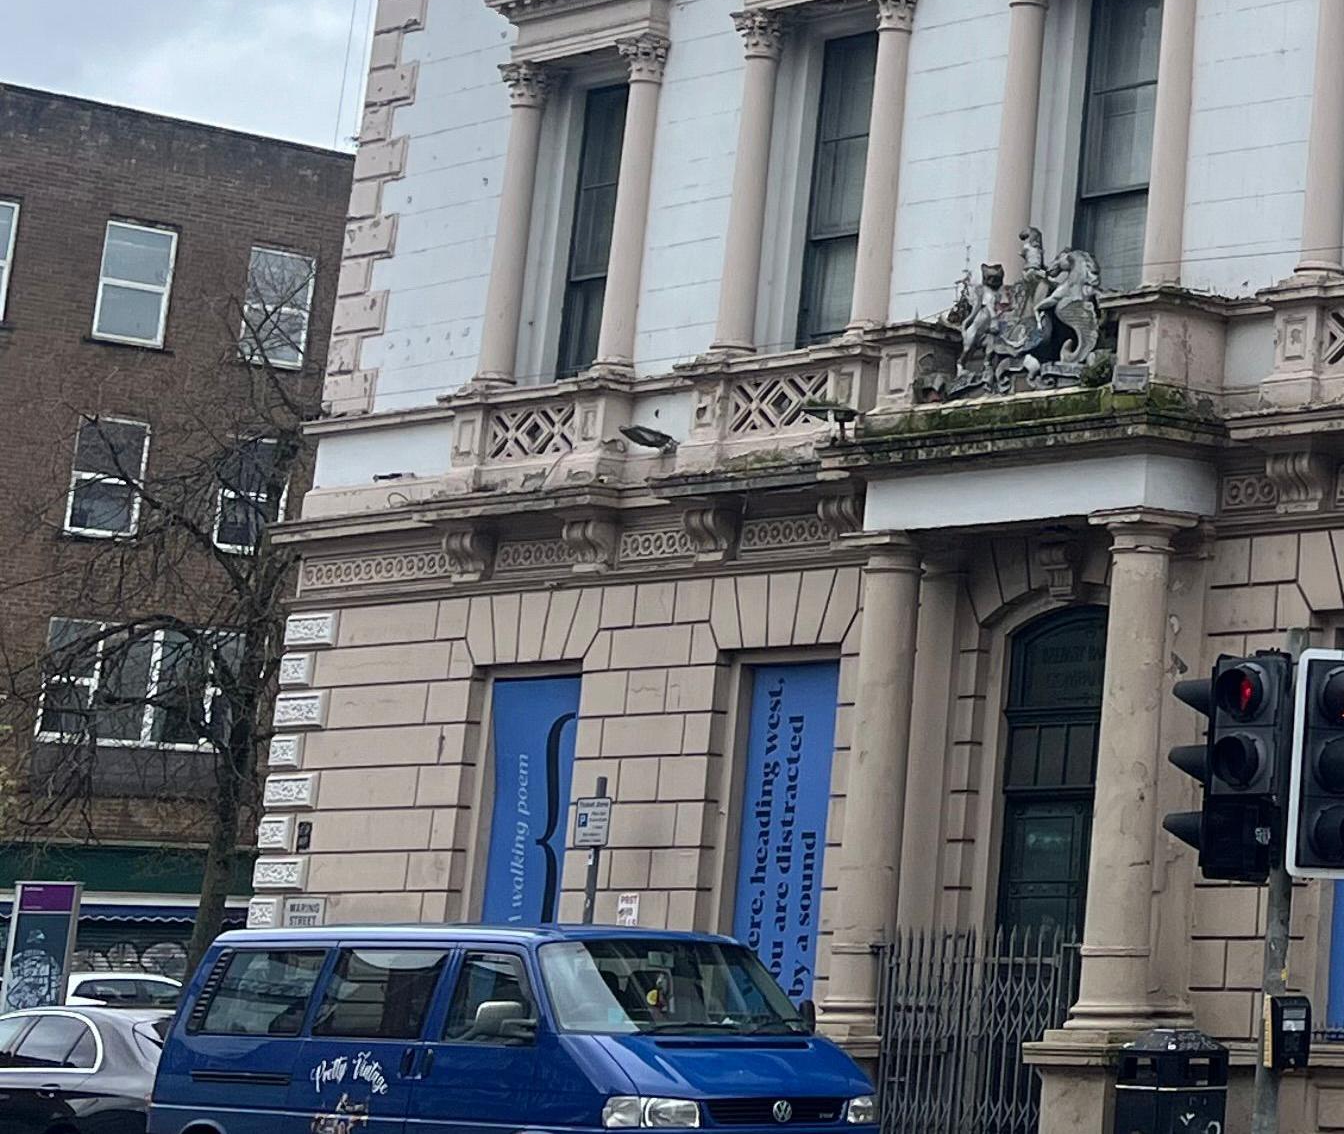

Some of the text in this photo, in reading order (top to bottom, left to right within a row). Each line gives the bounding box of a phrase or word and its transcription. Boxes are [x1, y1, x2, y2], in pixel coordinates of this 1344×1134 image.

[511, 821, 529, 907] walking
[518, 754, 531, 816] poem
[748, 677, 786, 954] ere, heading west,
[770, 715, 804, 979] ou are distracted
[788, 832, 816, 997] by a sound
